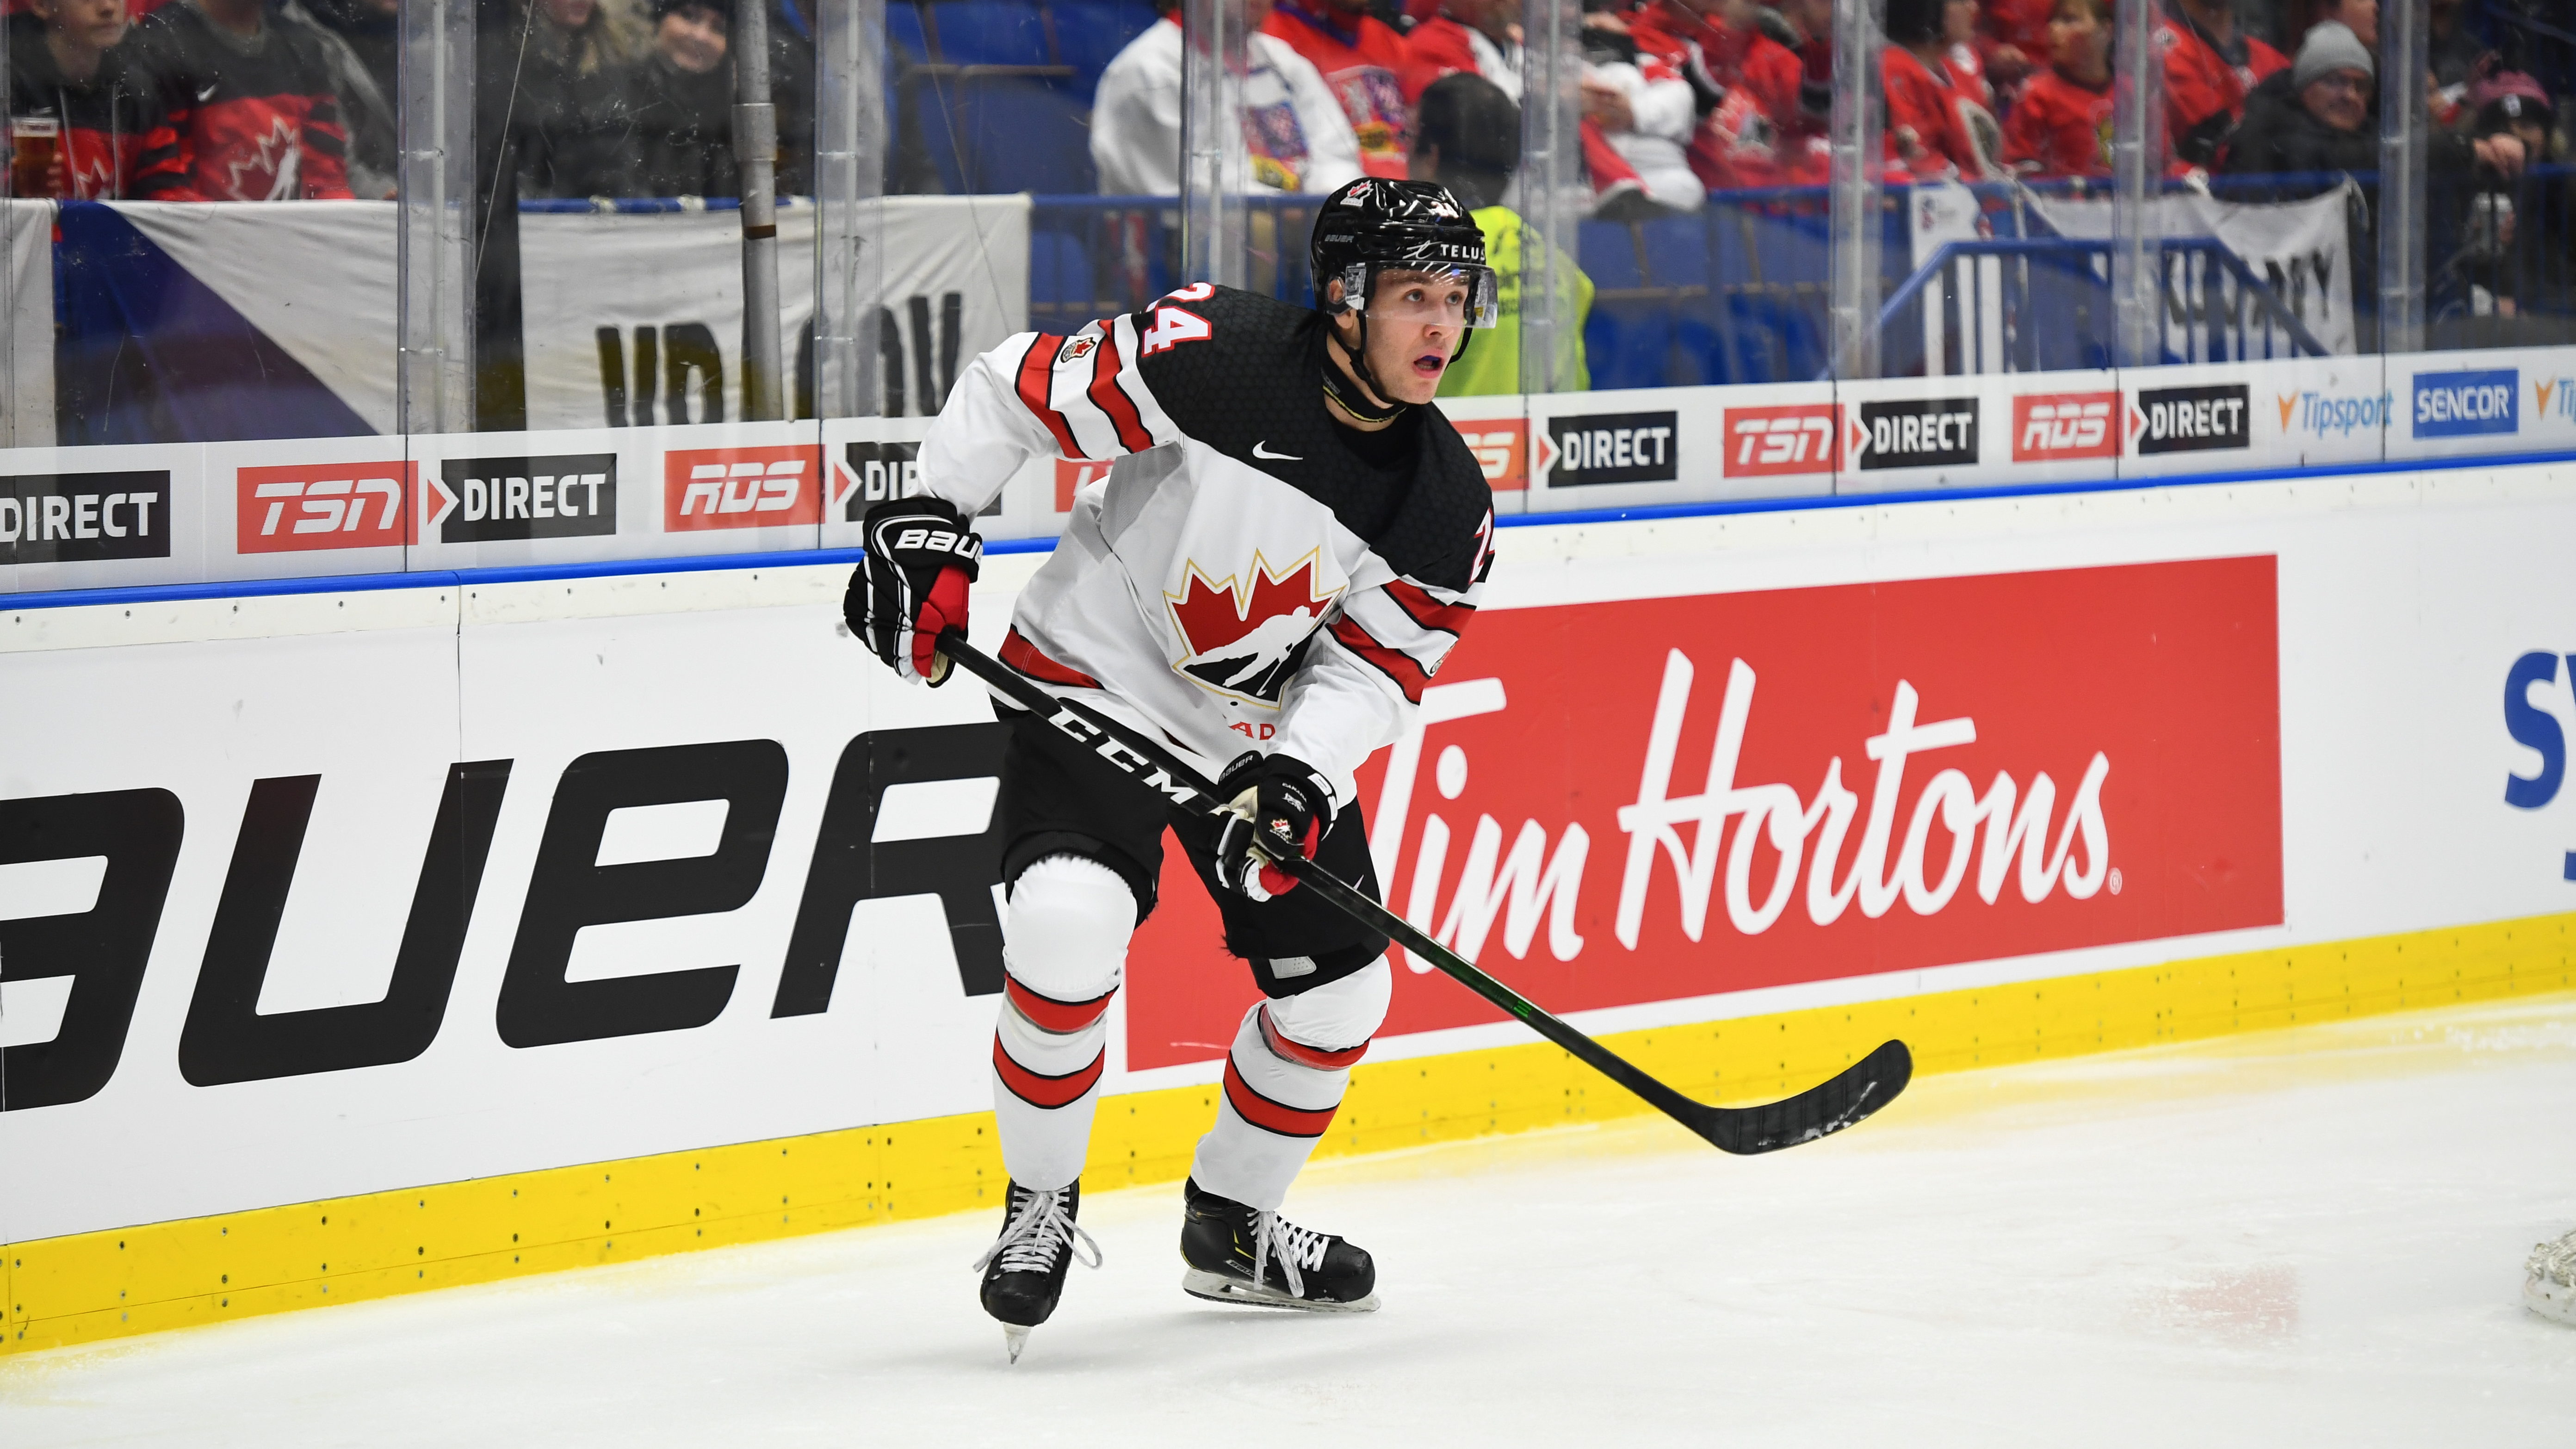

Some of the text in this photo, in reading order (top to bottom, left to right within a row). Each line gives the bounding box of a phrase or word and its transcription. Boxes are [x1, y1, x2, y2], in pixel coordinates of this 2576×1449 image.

[2023, 402, 2111, 450] RDS
[2150, 397, 2243, 440] DIRECT
[2302, 390, 2394, 439] Tipsport
[2417, 384, 2509, 424] SENCOR
[1561, 426, 1671, 471] DIRECT
[1734, 416, 1834, 465] TSN
[1873, 412, 1972, 455] DIRECT
[463, 473, 606, 522] DIRECT
[679, 460, 806, 516] RDS
[865, 460, 920, 502] DIR
[0, 492, 158, 544] DIRECT
[254, 478, 402, 536] TSN
[894, 529, 983, 566] BAU
[1048, 706, 1199, 805] CCM
[1220, 755, 1253, 781] BAUER
[1367, 647, 2110, 974] Tim Hortons
